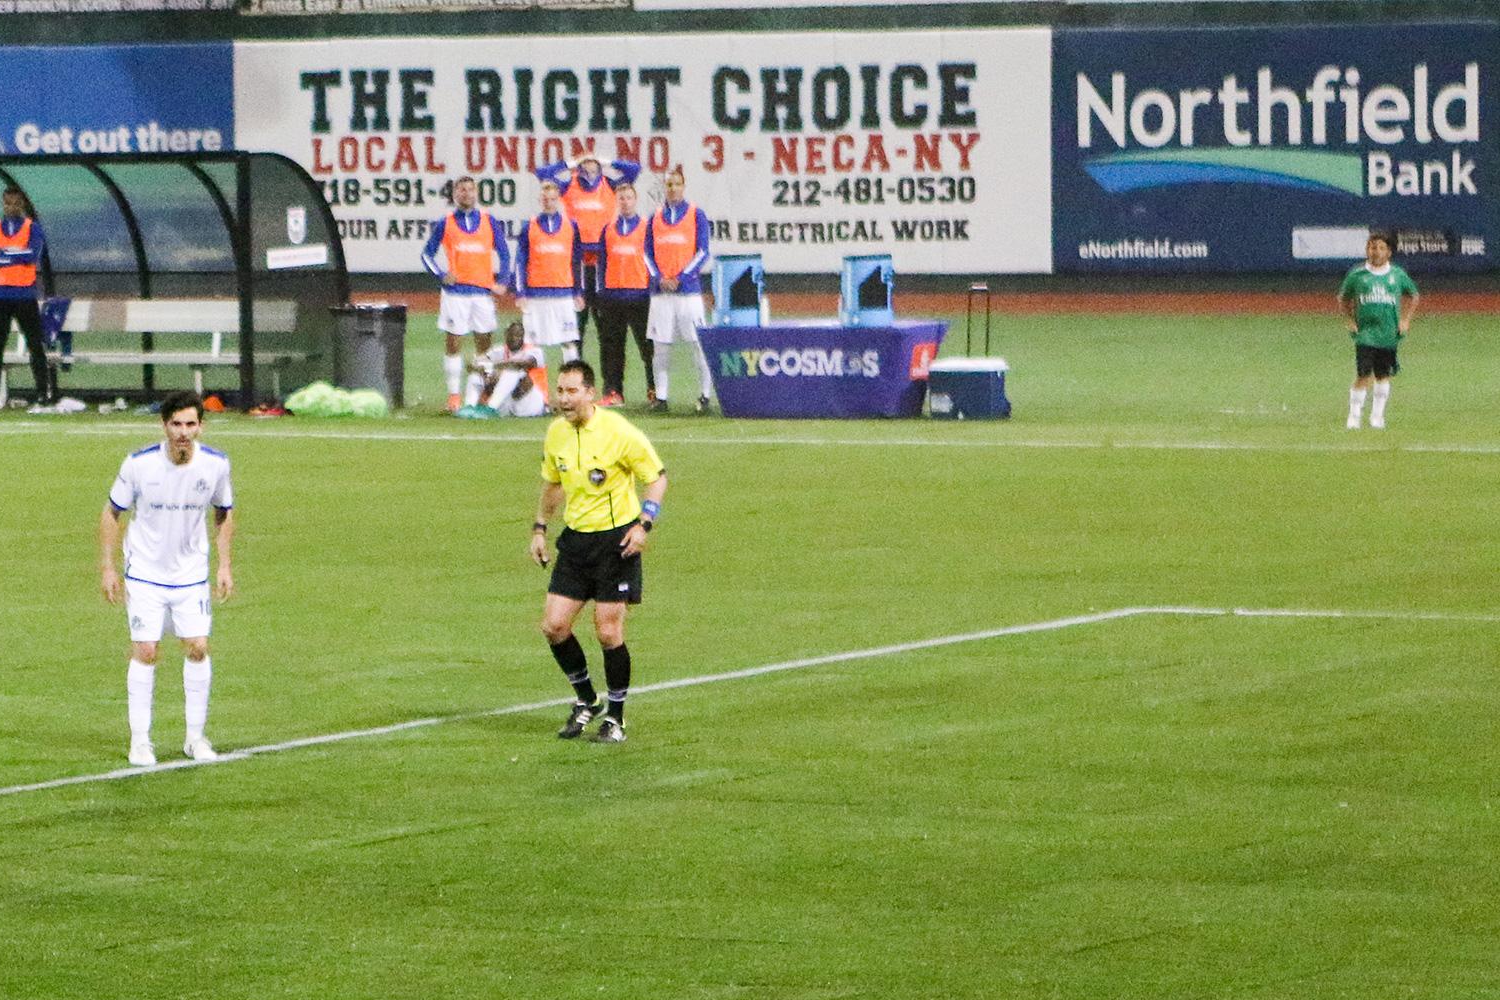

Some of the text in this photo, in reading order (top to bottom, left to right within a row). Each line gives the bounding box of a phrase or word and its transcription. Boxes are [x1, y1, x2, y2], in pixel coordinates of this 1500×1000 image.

[300, 62, 977, 133] THE RIGHT CHOICE
[1077, 62, 1480, 148] Northfield
[15, 123, 222, 153] Get out there
[311, 137, 446, 174] LOCAL
[463, 135, 596, 173] UNION
[702, 134, 725, 173] 3
[771, 133, 981, 174] NECA-NY
[1367, 150, 1477, 196] Bank
[772, 176, 976, 206] 212-481-0530
[737, 219, 883, 242] ELECTRICAL
[891, 218, 970, 240] WORK
[1078, 238, 1209, 259] eNorthfield.com
